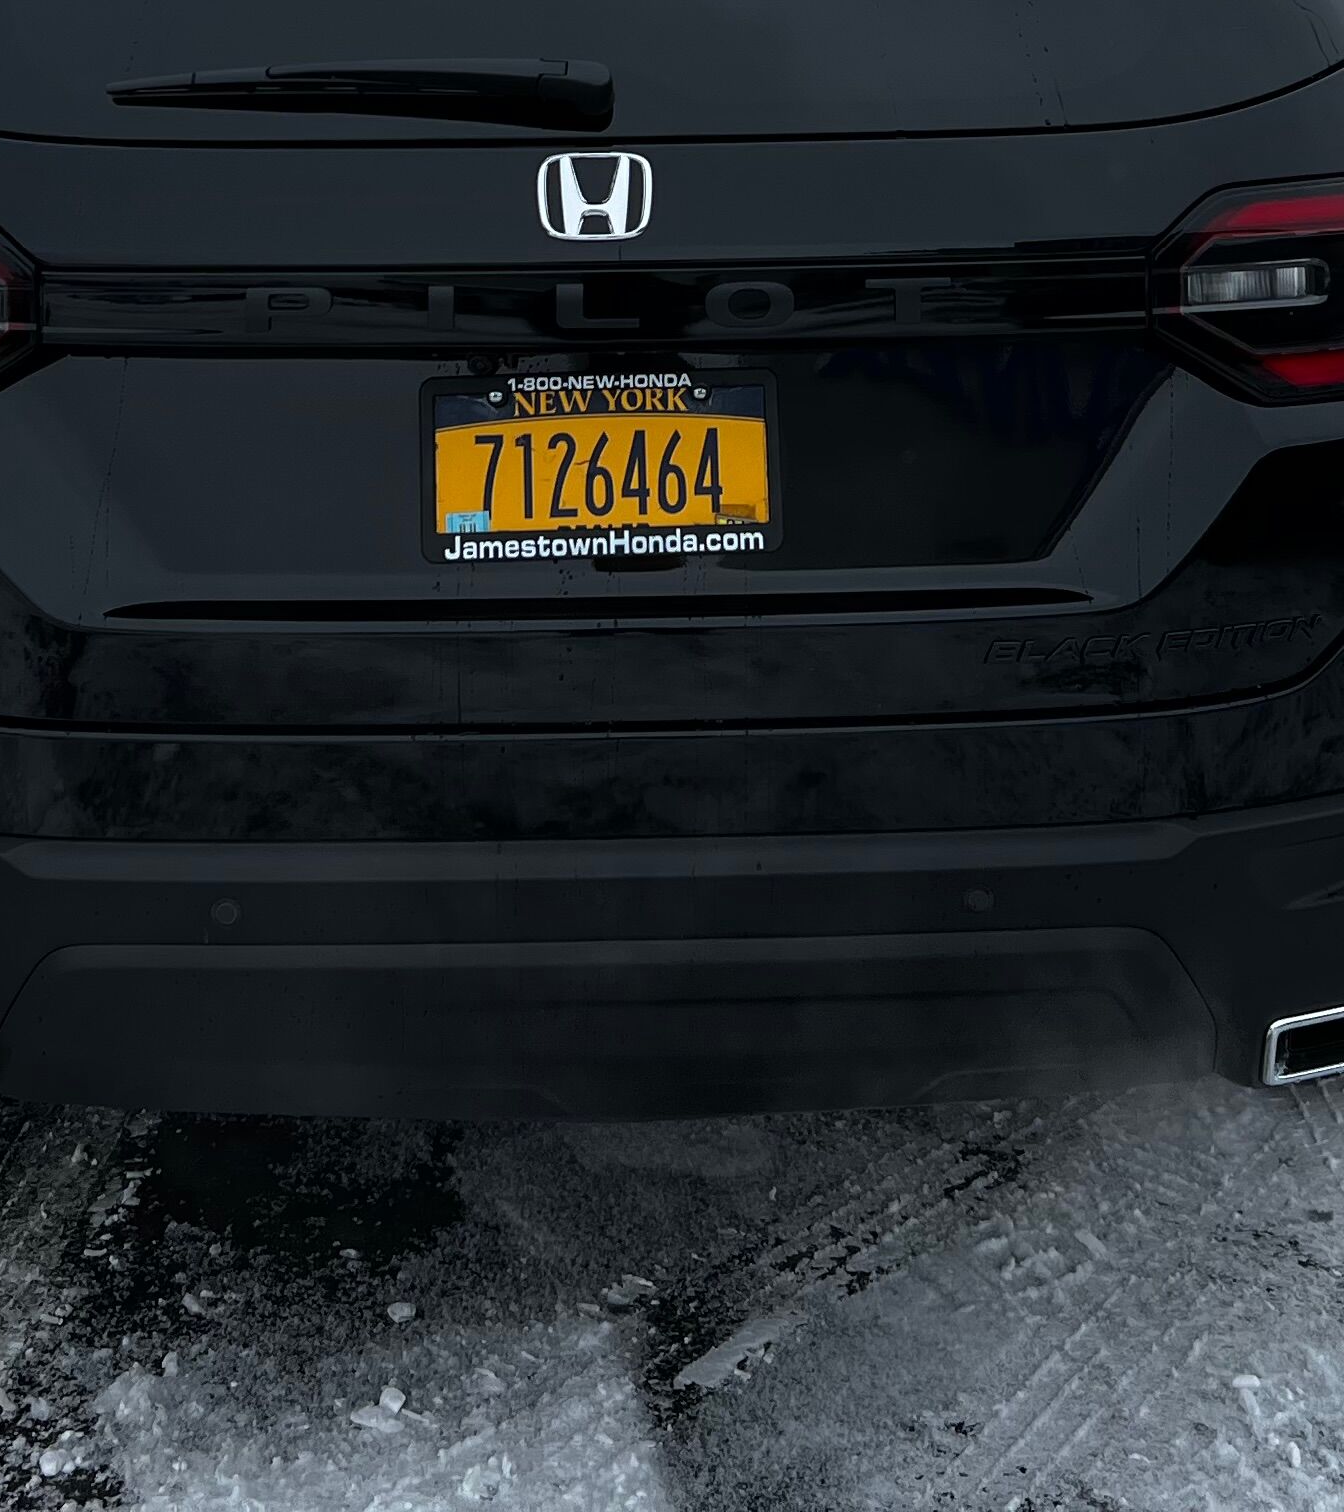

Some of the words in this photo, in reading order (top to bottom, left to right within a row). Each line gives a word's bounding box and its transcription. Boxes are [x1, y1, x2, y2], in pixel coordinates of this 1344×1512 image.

[245, 278, 952, 333] PILOT
[507, 372, 692, 392] 1-800-NEW-HONDA
[513, 390, 593, 418] NEW
[602, 387, 689, 412] YORK
[474, 427, 724, 521] 7126464
[445, 528, 765, 561] JamestownHonda.com
[983, 631, 1151, 665] BLACK
[1155, 613, 1323, 662] EDITION
